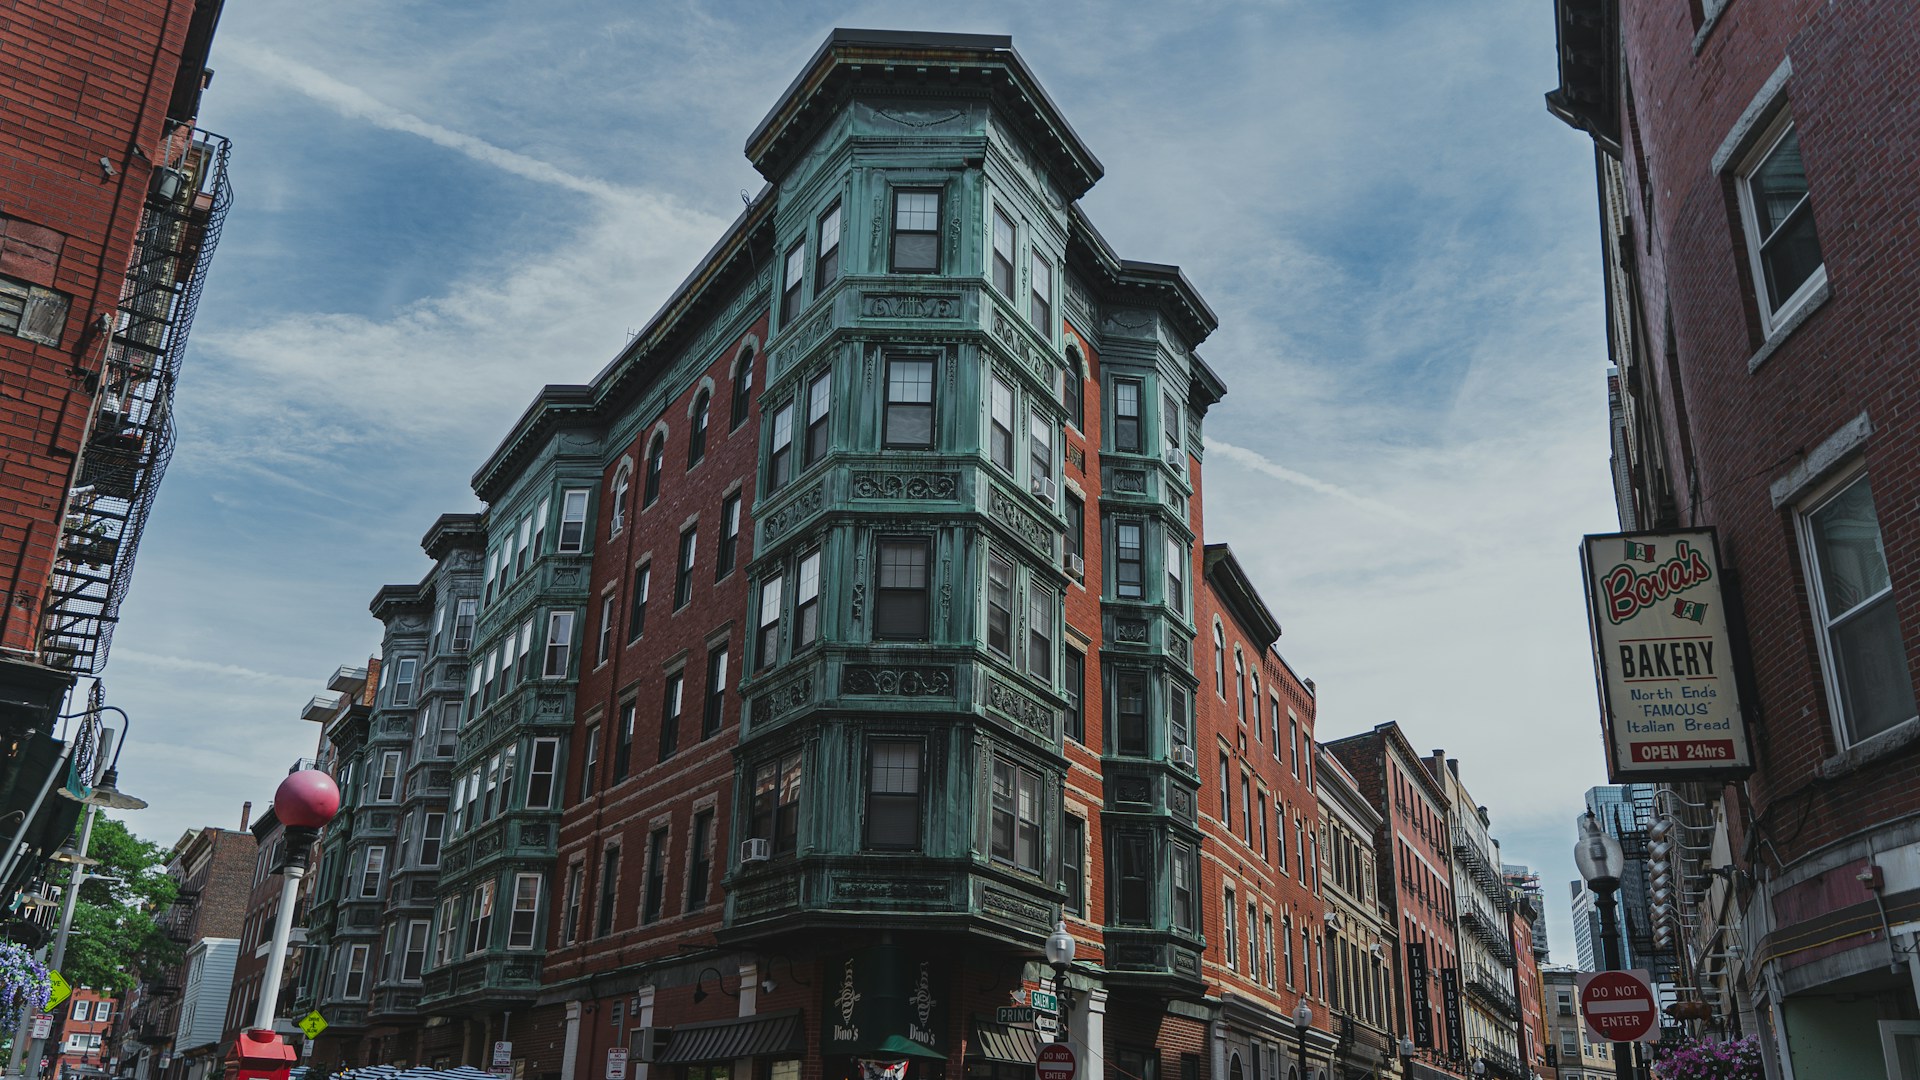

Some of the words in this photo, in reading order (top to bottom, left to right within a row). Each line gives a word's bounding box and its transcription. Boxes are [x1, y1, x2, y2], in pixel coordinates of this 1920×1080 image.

[1602, 540, 1711, 625] Bova's
[1619, 641, 1714, 679] BAKERY
[1631, 688, 1673, 701] North
[1682, 684, 1717, 699] End's
[1638, 702, 1712, 717] "FAMOUS"
[1627, 719, 1675, 733] Italian
[1685, 718, 1730, 731] Bread
[1641, 745, 1679, 760] OPEN
[1686, 742, 1726, 759] 24hrs
[1412, 947, 1428, 1042] LIBERTINE
[1592, 987, 1609, 998] DO
[1615, 985, 1638, 997] NOT
[1034, 993, 1049, 1009] SALEM
[1001, 1008, 1034, 1022] PRINC
[1445, 972, 1460, 1057] LIBERTINE
[1601, 1015, 1641, 1028] ENTER
[833, 1024, 859, 1041] Dino's
[909, 1023, 936, 1046] Dino's
[1043, 1052, 1054, 1060] DO
[1055, 1052, 1069, 1060] NOT
[1045, 1071, 1067, 1079] ENTER
